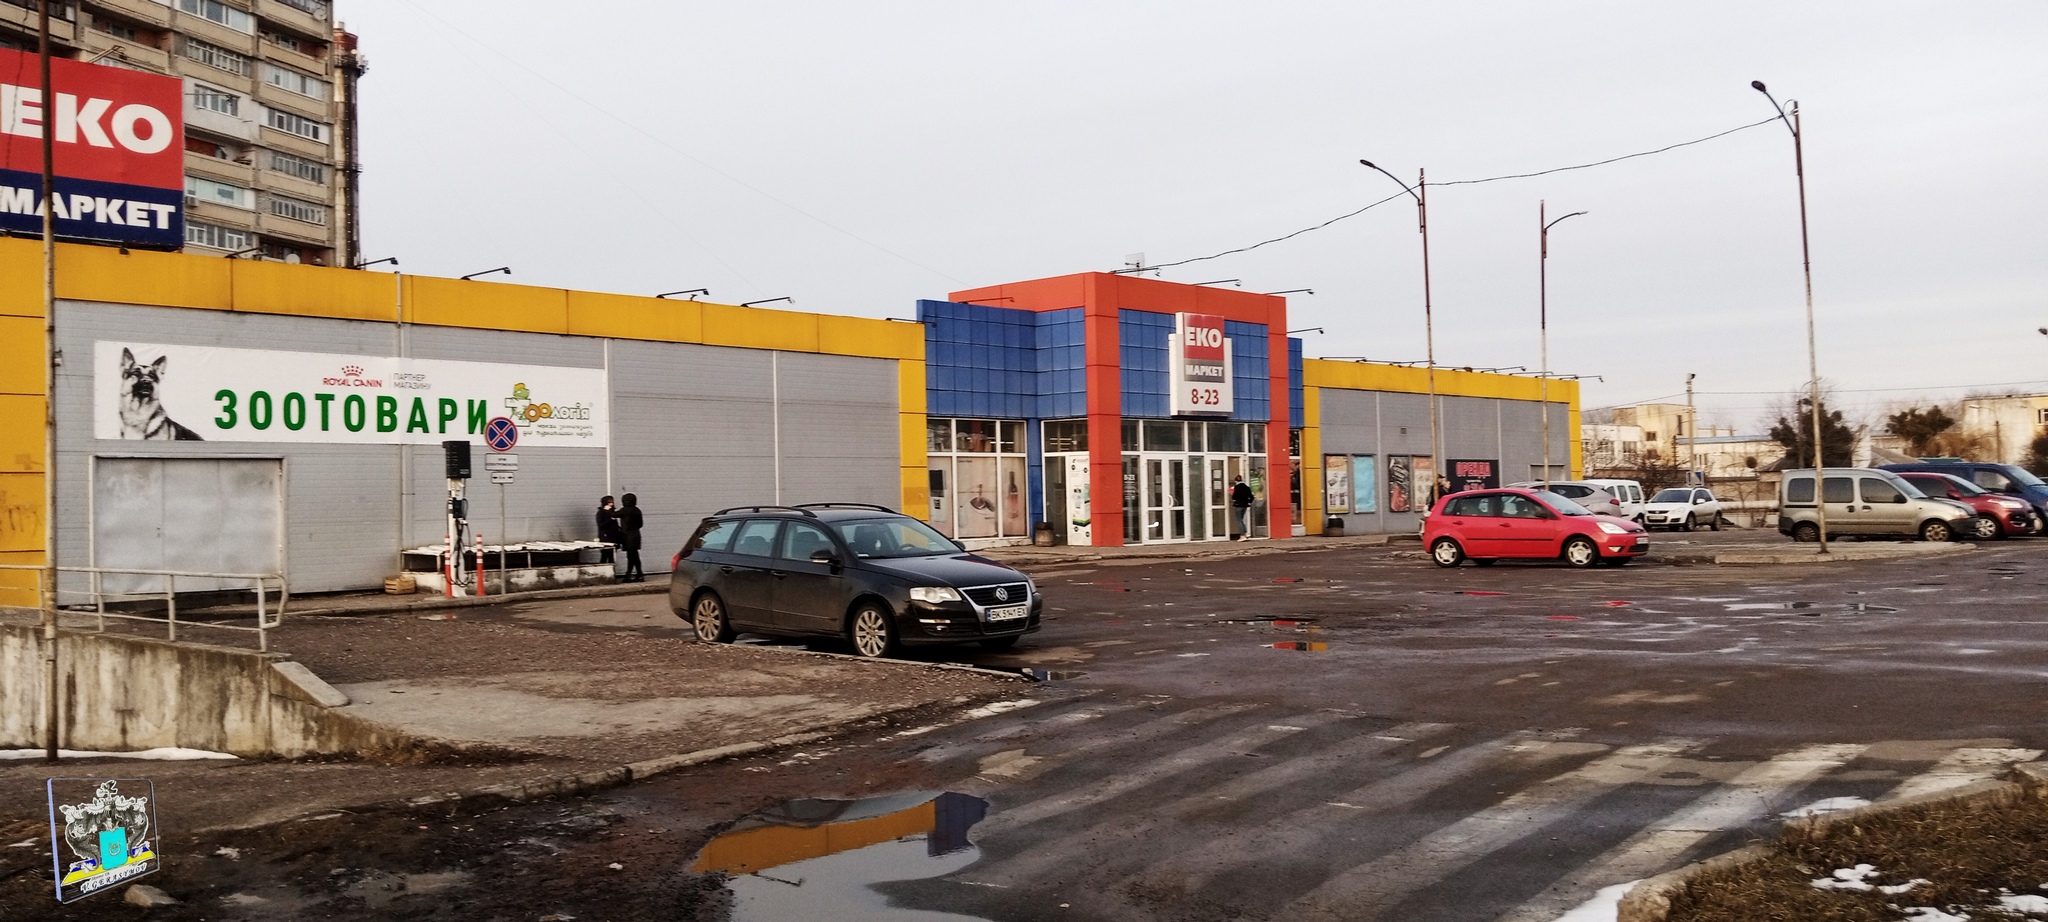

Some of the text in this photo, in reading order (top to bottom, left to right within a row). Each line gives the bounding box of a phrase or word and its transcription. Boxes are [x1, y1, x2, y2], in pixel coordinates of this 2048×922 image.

[0, 83, 173, 154] ЕКО
[0, 185, 176, 230] МАРКЕТ
[1185, 326, 1222, 348] ЕКО
[394, 373, 426, 381] ПАРТНЕР
[1185, 364, 1224, 377] МАРКЕТ
[323, 378, 382, 388] ROYAL CANIN
[394, 381, 432, 390] МАГАЗИНУ
[1191, 388, 1219, 405] 8-23
[213, 389, 487, 435] ЗООТОВАРИ
